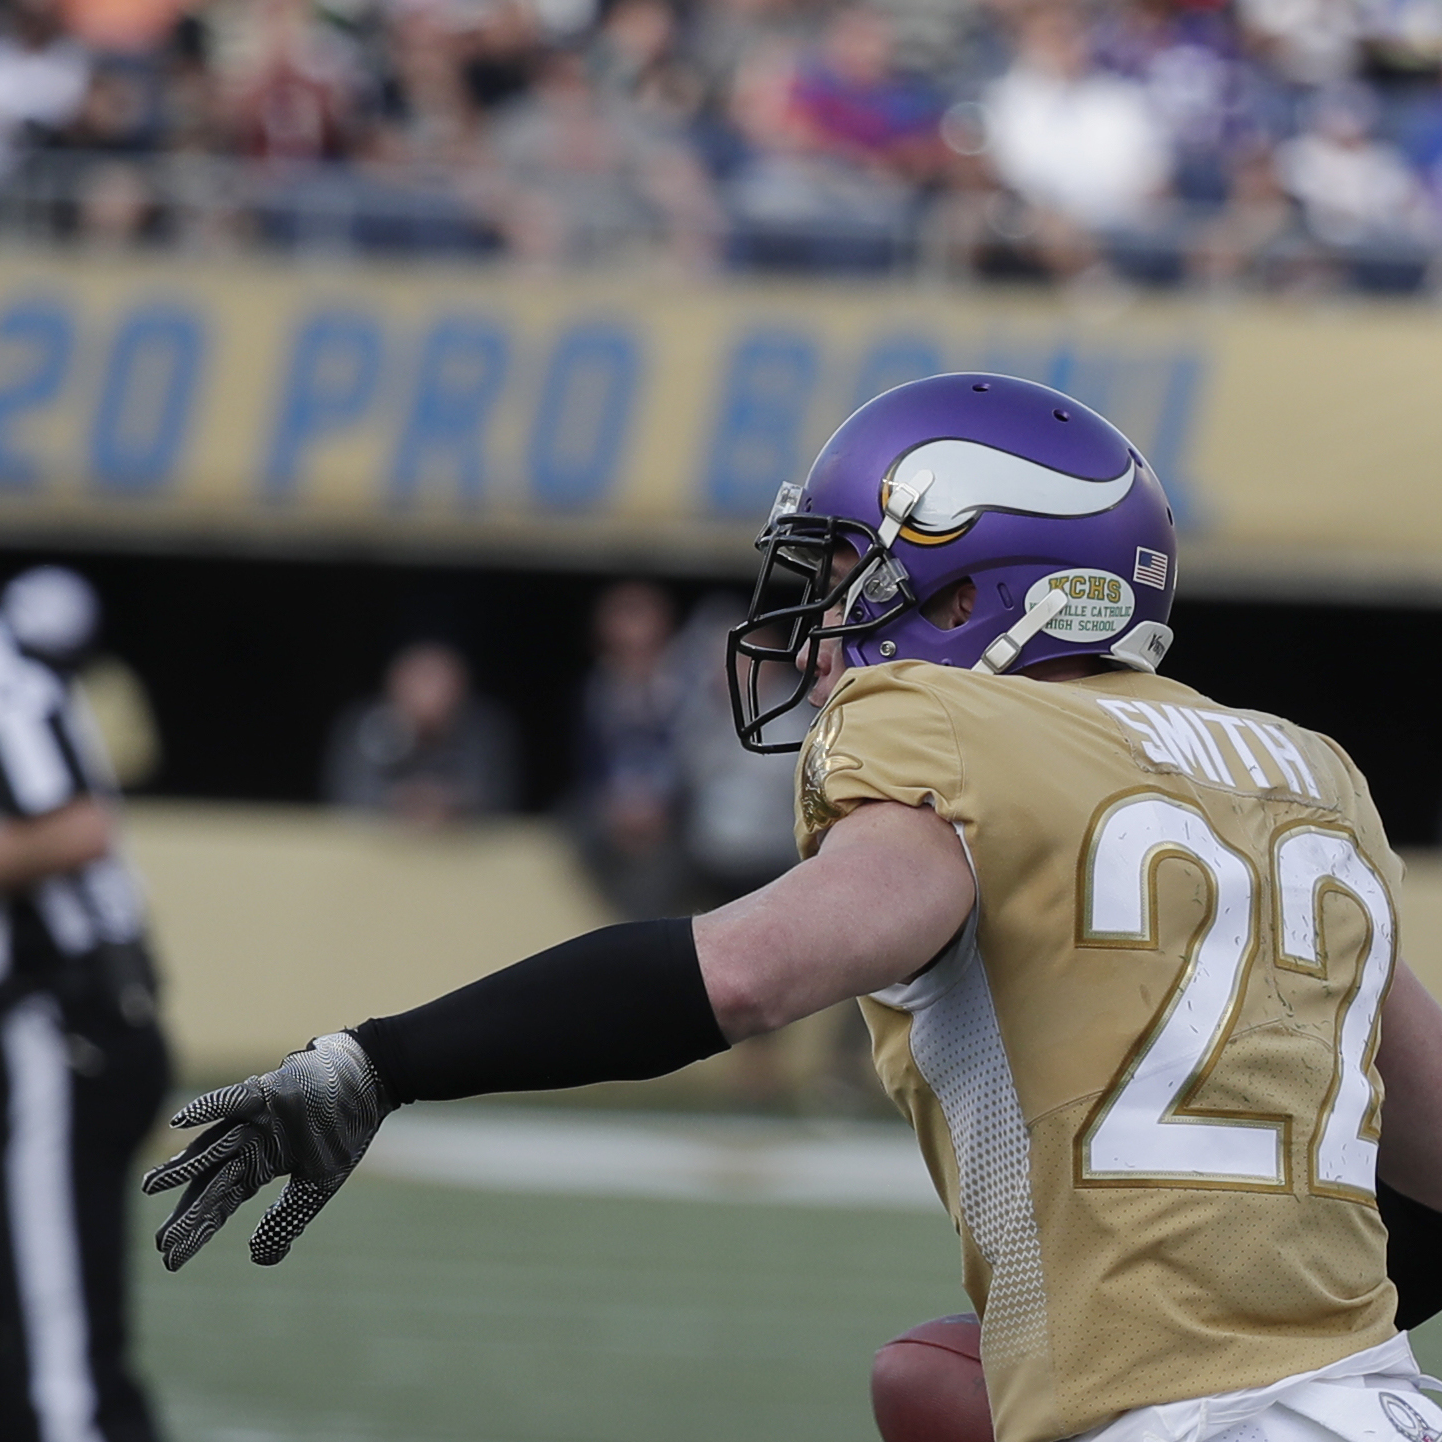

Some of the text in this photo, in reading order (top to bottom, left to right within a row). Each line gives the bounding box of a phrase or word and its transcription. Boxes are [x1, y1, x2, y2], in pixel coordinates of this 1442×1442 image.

[261, 308, 642, 508] PRO
[1049, 575, 1121, 604] KCHS
[1091, 606, 1132, 617] CATHOLIC
[1045, 619, 1116, 632] HIGH SCHOOL
[1096, 699, 1321, 800] SMITH
[1074, 785, 1398, 1210] 22
